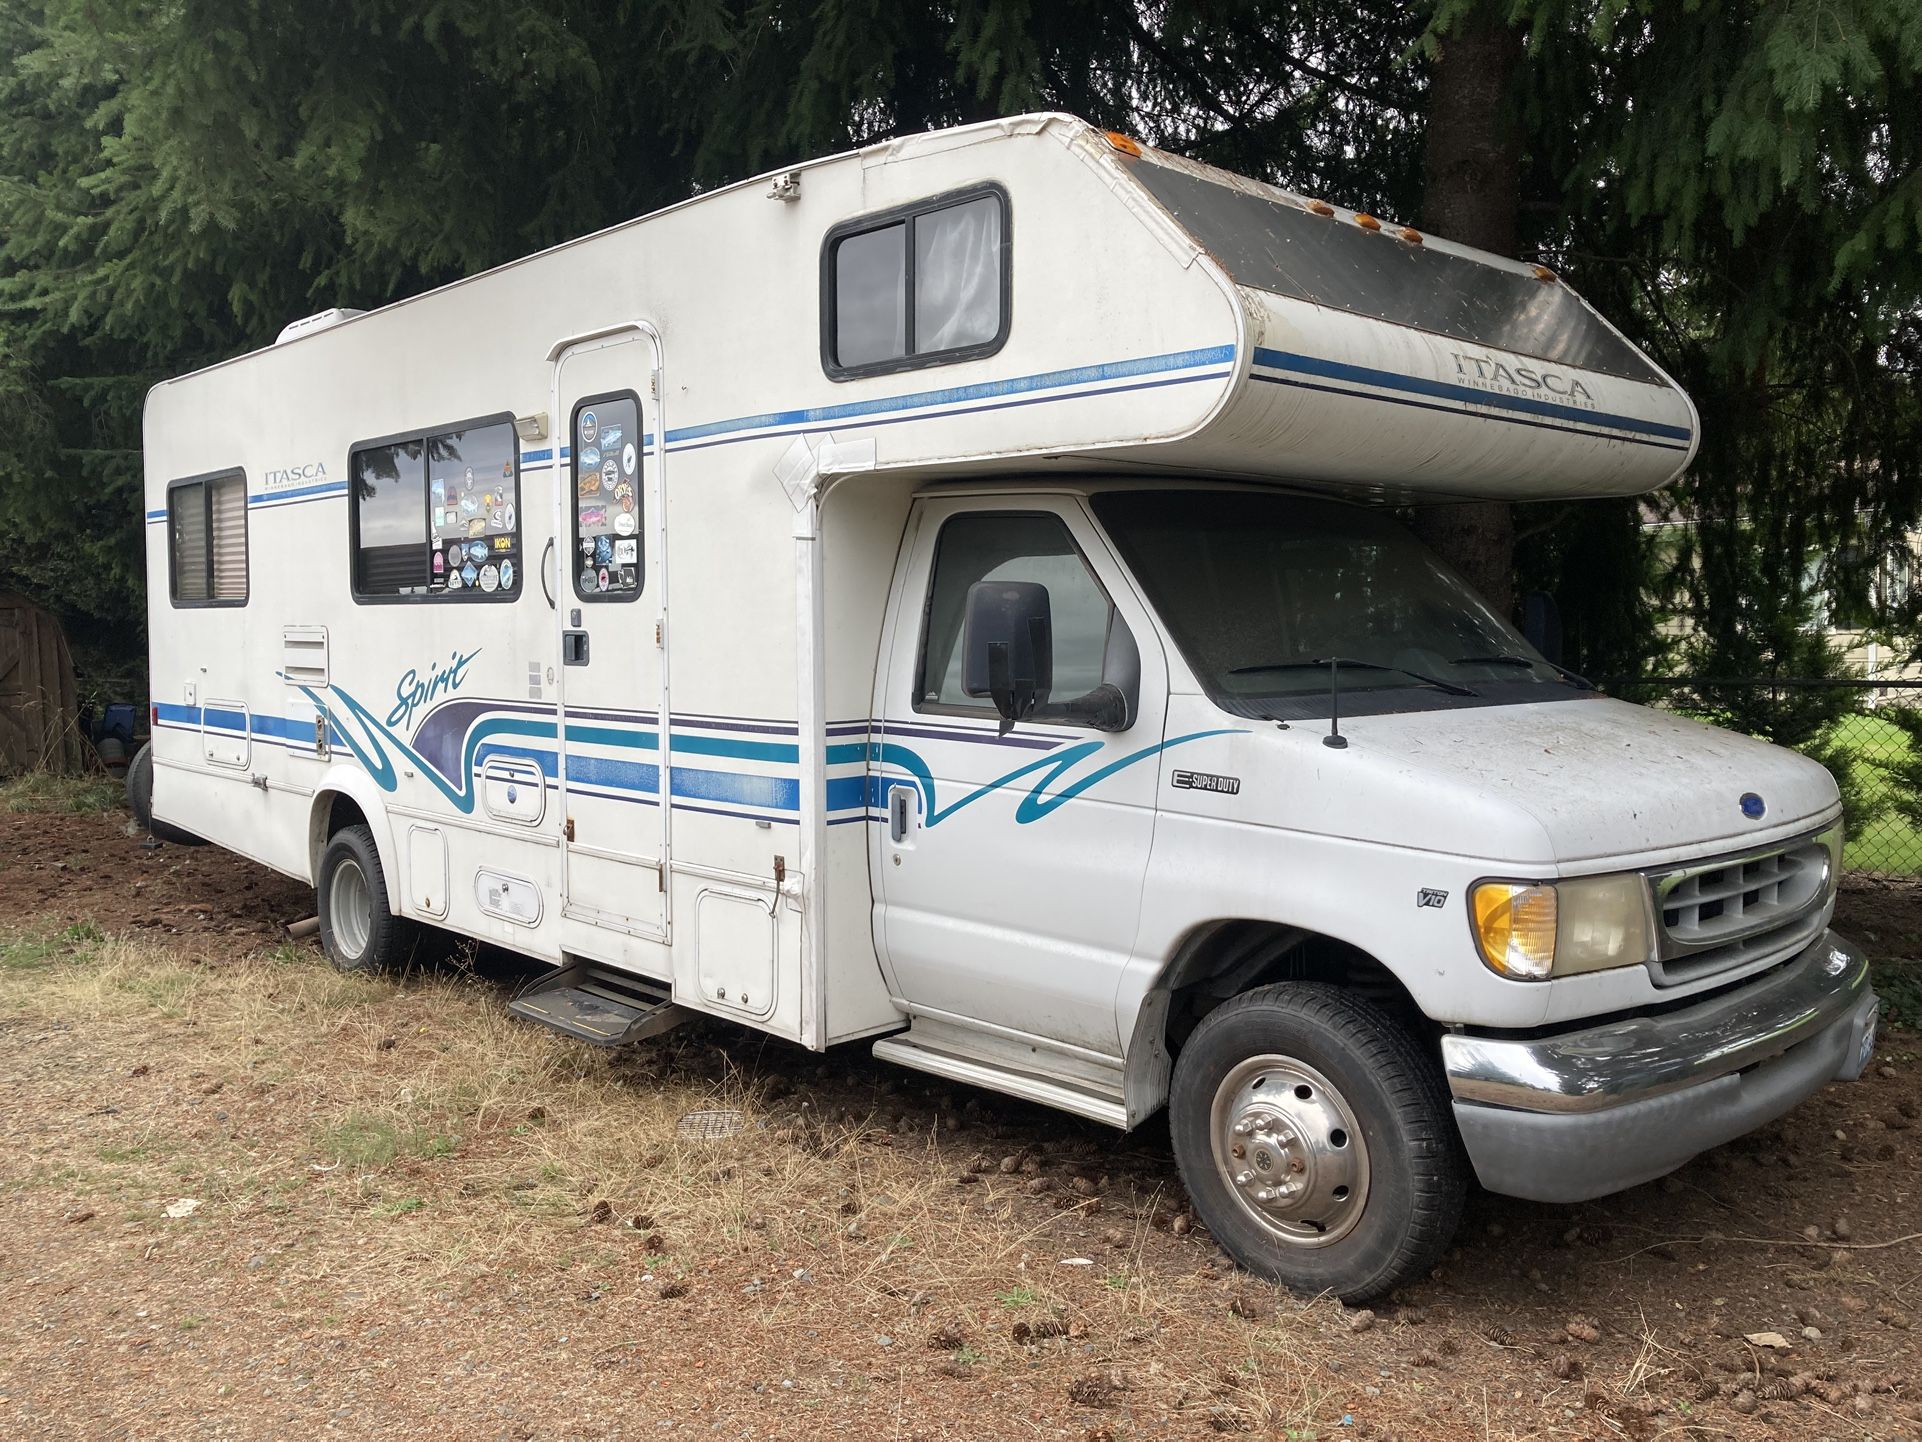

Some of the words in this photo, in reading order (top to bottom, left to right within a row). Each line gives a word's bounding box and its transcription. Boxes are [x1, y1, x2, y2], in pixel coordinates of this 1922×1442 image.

[1451, 352, 1594, 400] ITASCA
[1458, 376, 1528, 397] WINNEBAGO
[1532, 391, 1596, 410] INDUSTRIES
[265, 462, 327, 486] ITASCA
[494, 537, 511, 549] IKON
[386, 648, 482, 731] Spirit
[1217, 777, 1239, 793] DUTY
[1418, 892, 1445, 907] V10
